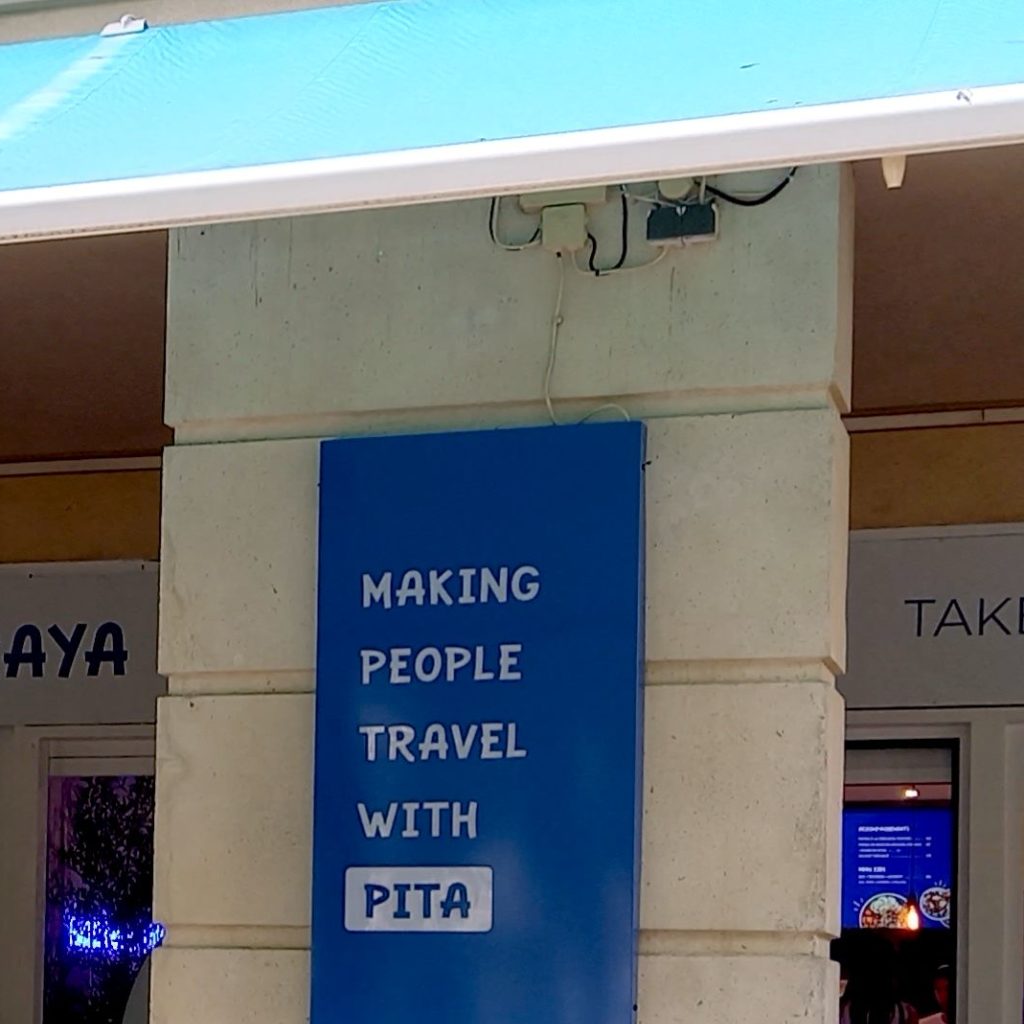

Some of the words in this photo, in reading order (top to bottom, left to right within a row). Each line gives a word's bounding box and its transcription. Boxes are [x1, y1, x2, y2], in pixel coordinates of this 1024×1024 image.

[361, 565, 541, 608] MAKING
[360, 643, 523, 684] PEOPLE
[358, 722, 528, 762] TRAVEL
[357, 800, 478, 840] WITH
[363, 882, 472, 919] PITA
